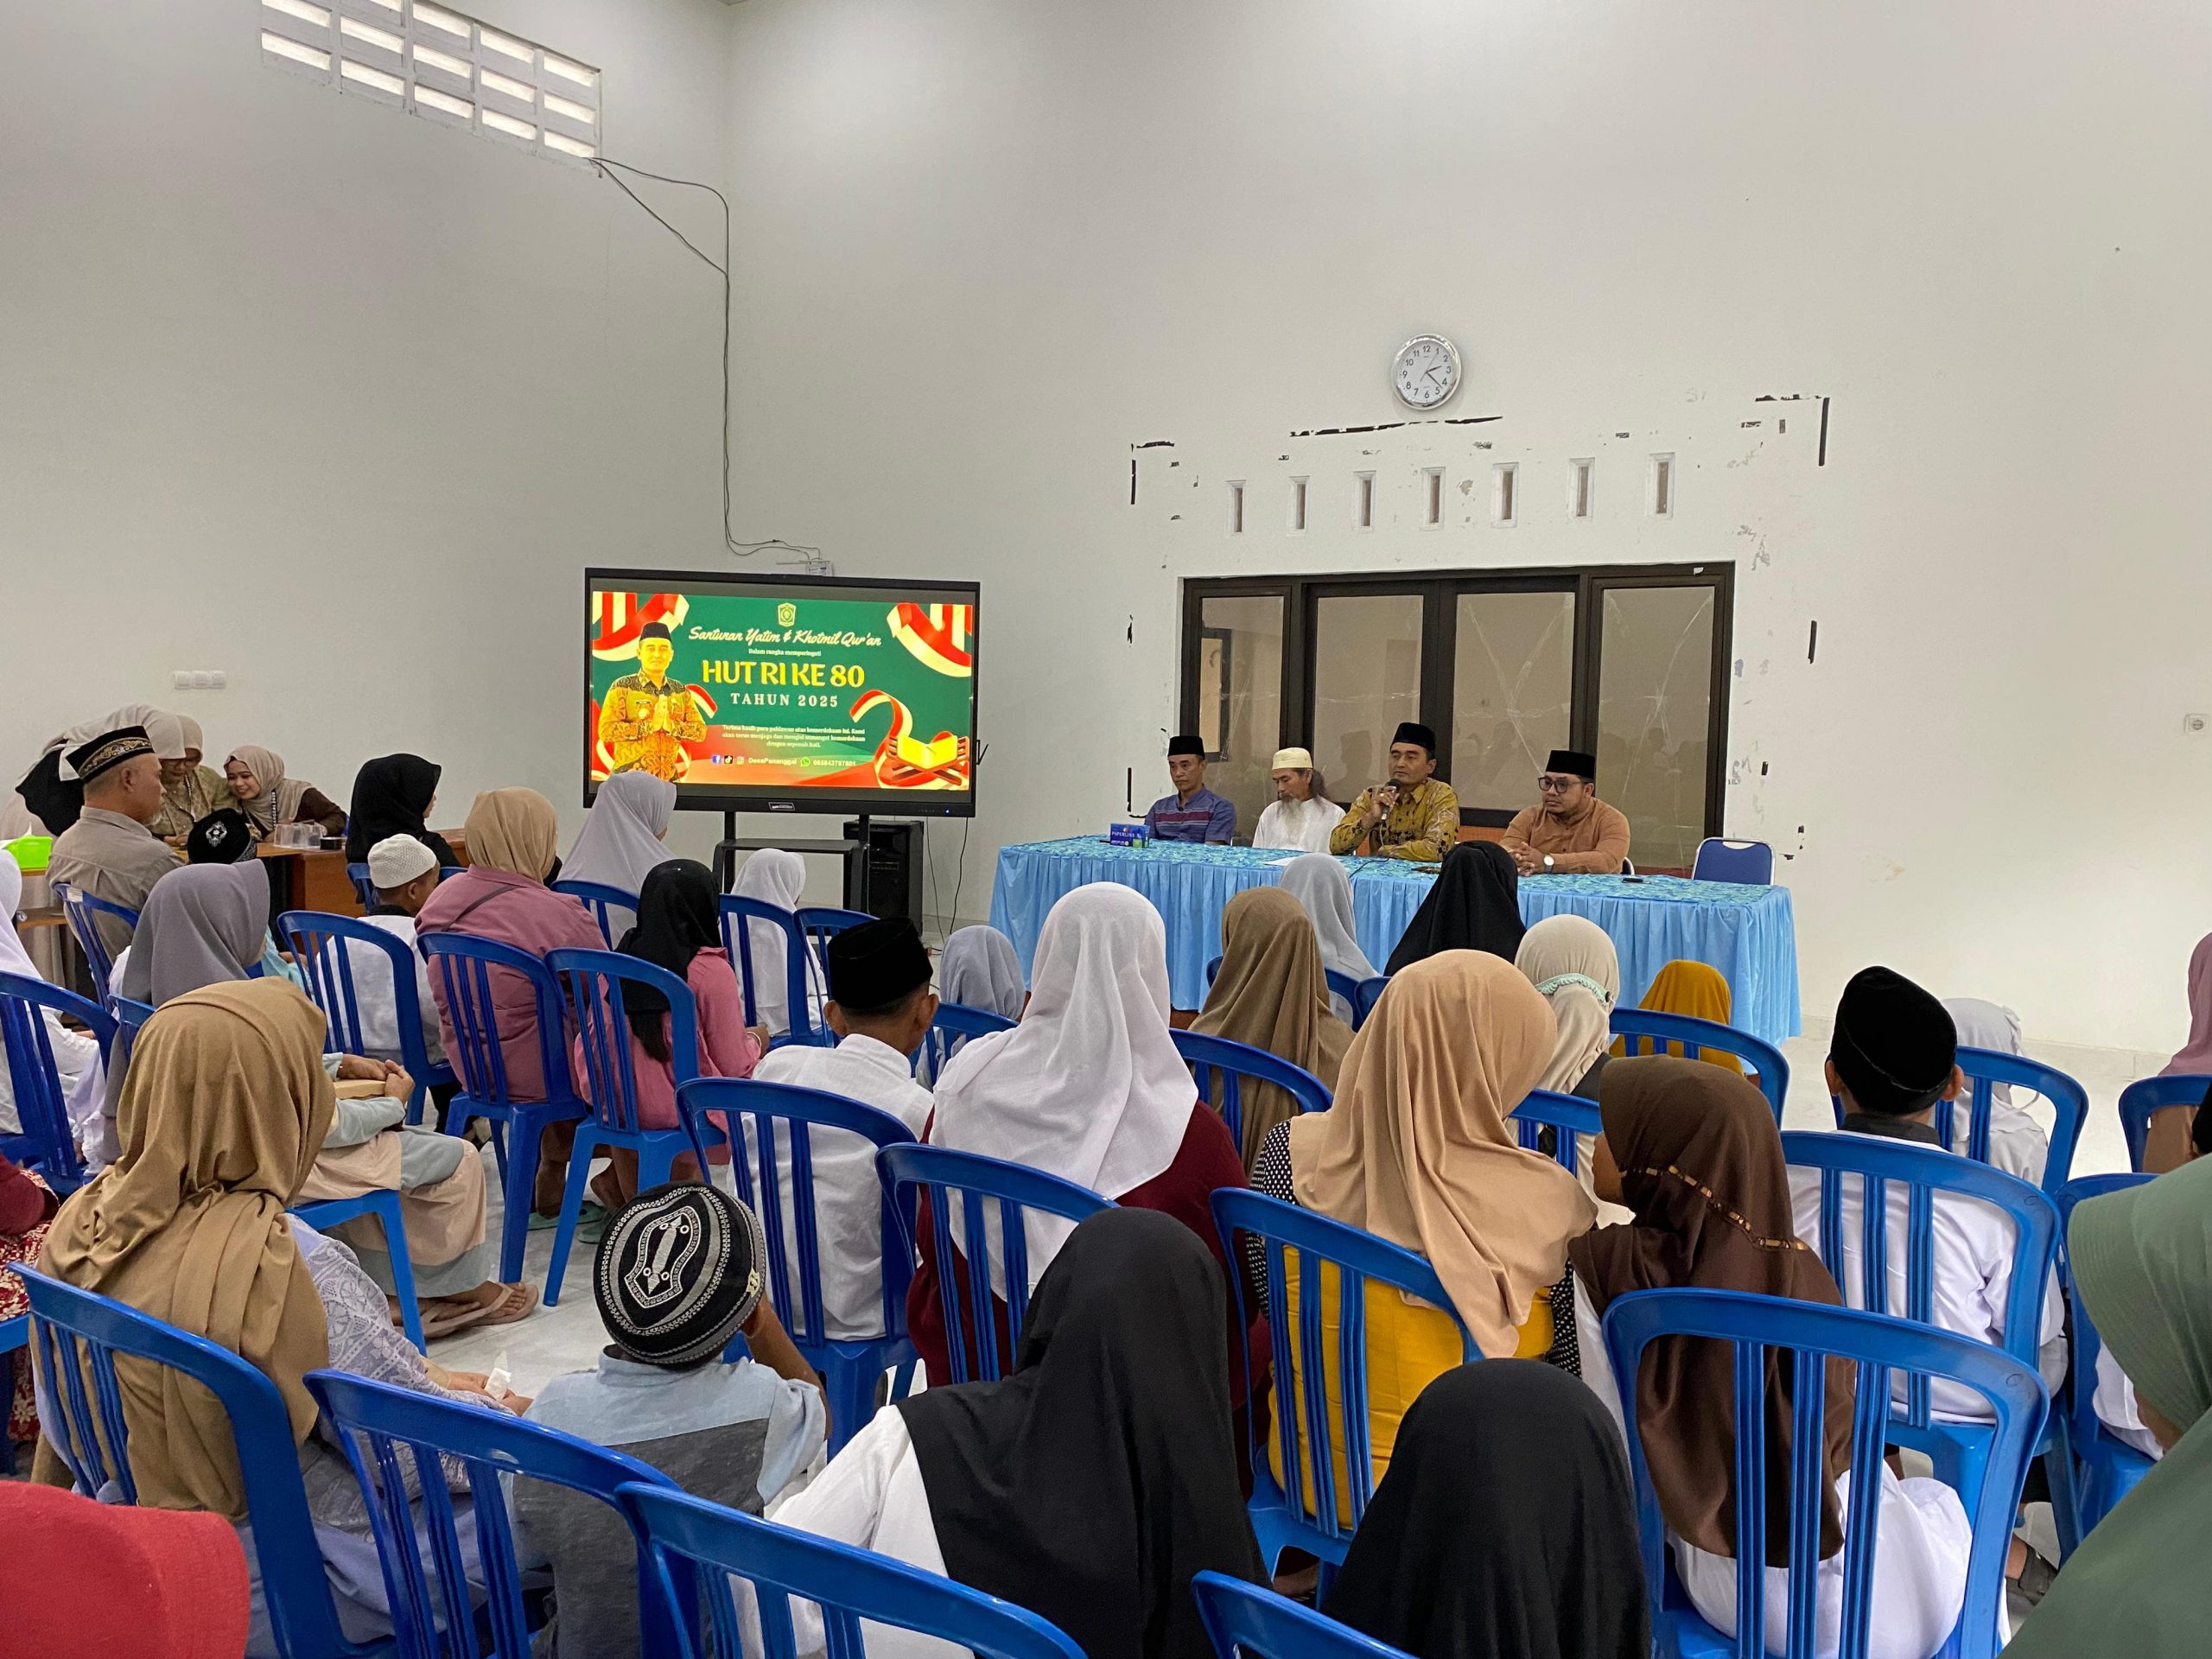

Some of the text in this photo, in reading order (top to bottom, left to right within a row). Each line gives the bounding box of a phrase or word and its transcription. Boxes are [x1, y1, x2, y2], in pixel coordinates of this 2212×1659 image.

[1443, 354, 1448, 363] 2
[1446, 365, 1452, 374] 3
[1406, 381, 1411, 390] 8
[1442, 377, 1447, 386] 4
[1435, 386, 1440, 395] 5
[689, 626, 743, 641] Santunan
[746, 628, 780, 646] Yatim
[792, 629, 842, 645] Khotmil
[702, 659, 865, 689] HUT RI KE 80
[730, 692, 838, 708] TAHUN 2025
